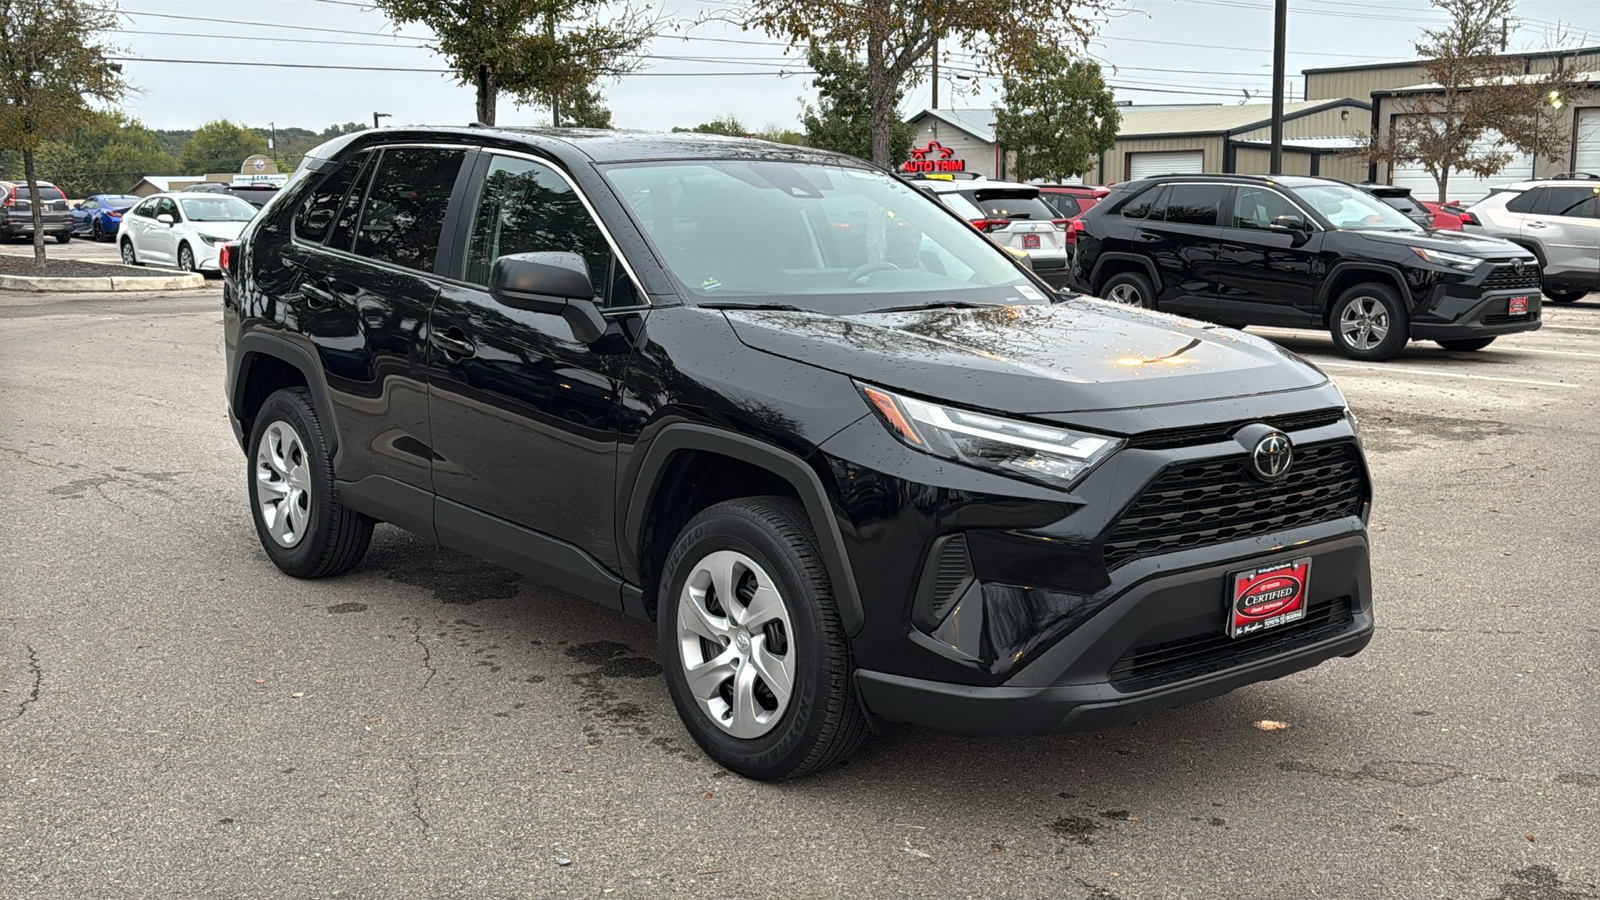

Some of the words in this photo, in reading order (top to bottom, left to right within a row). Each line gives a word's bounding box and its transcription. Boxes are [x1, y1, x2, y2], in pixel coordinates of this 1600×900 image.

[903, 160, 934, 172] AUTO
[935, 160, 964, 172] TRIM
[1245, 587, 1293, 606] CERTIFIED
